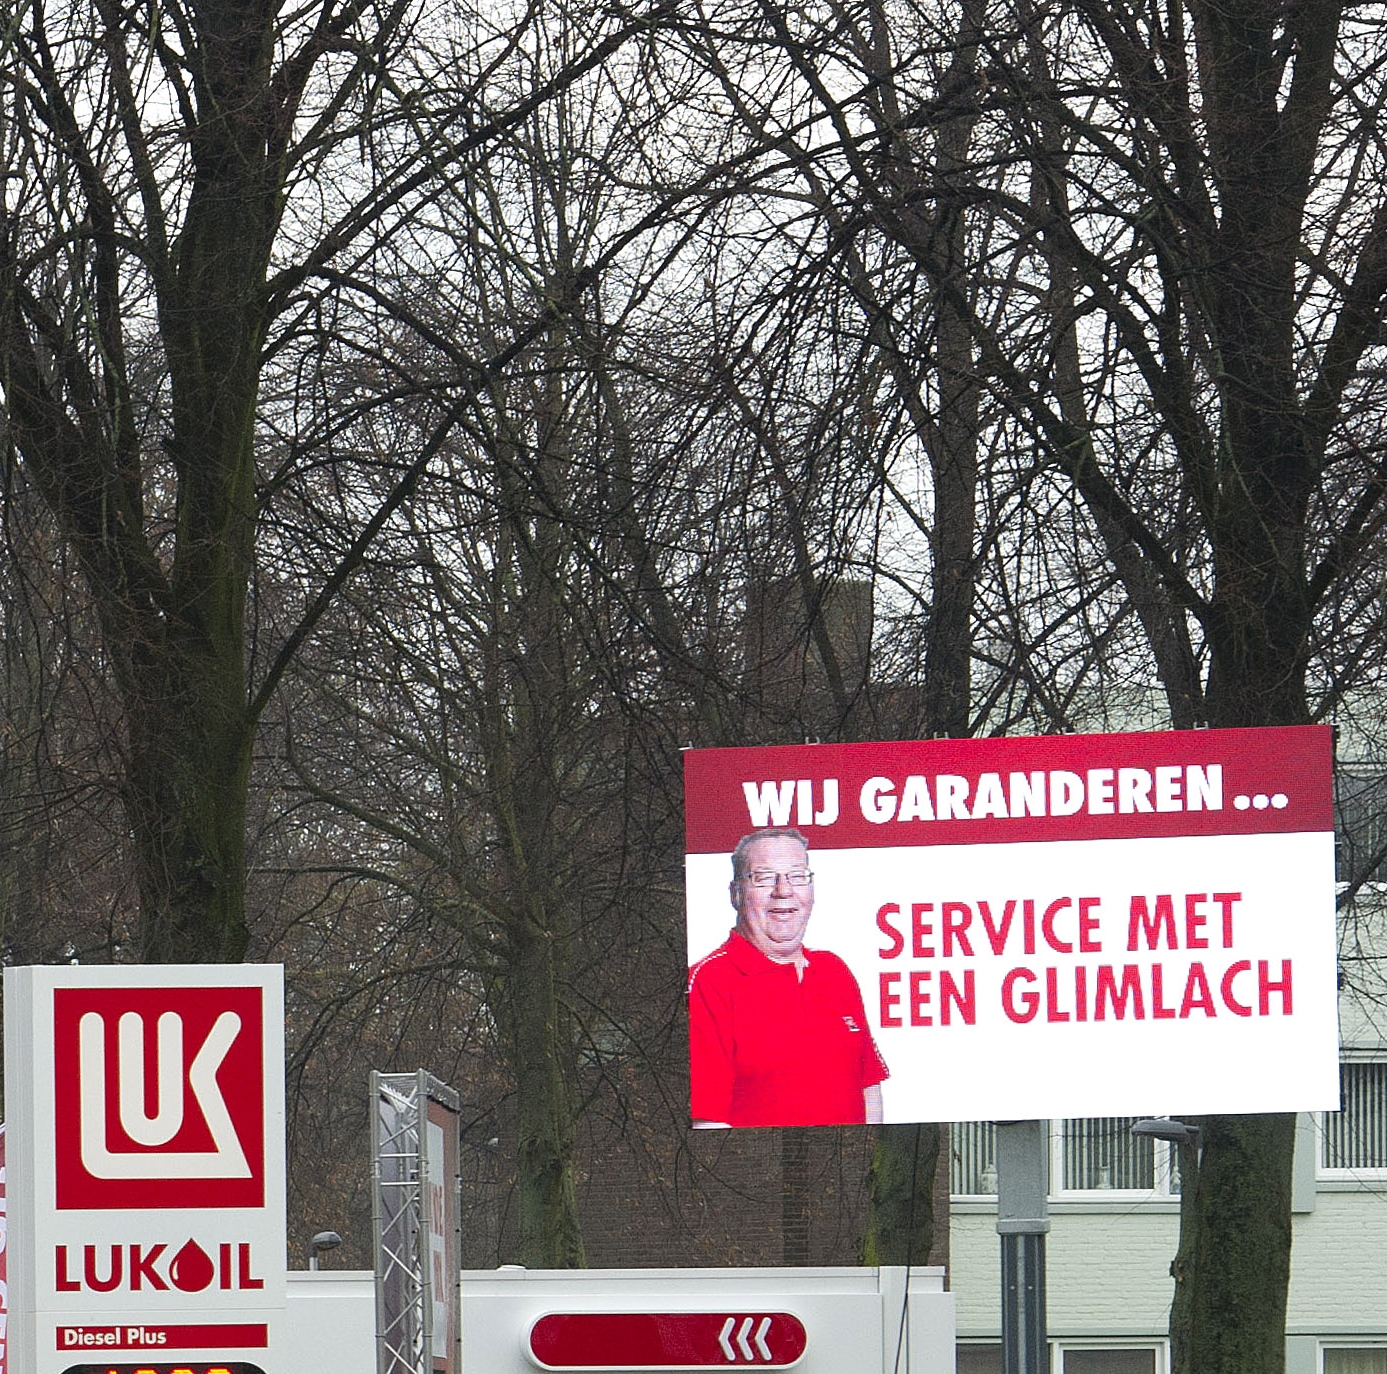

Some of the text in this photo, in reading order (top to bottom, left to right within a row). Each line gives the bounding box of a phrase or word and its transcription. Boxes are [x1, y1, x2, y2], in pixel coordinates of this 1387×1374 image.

[742, 778, 839, 827] WIJ
[877, 891, 1242, 959] SERVICE MET
[880, 958, 1293, 1028] EEN GLIMLACH
[55, 1237, 263, 1292] LUKOIL
[64, 1327, 167, 1346] Diesel Plus
